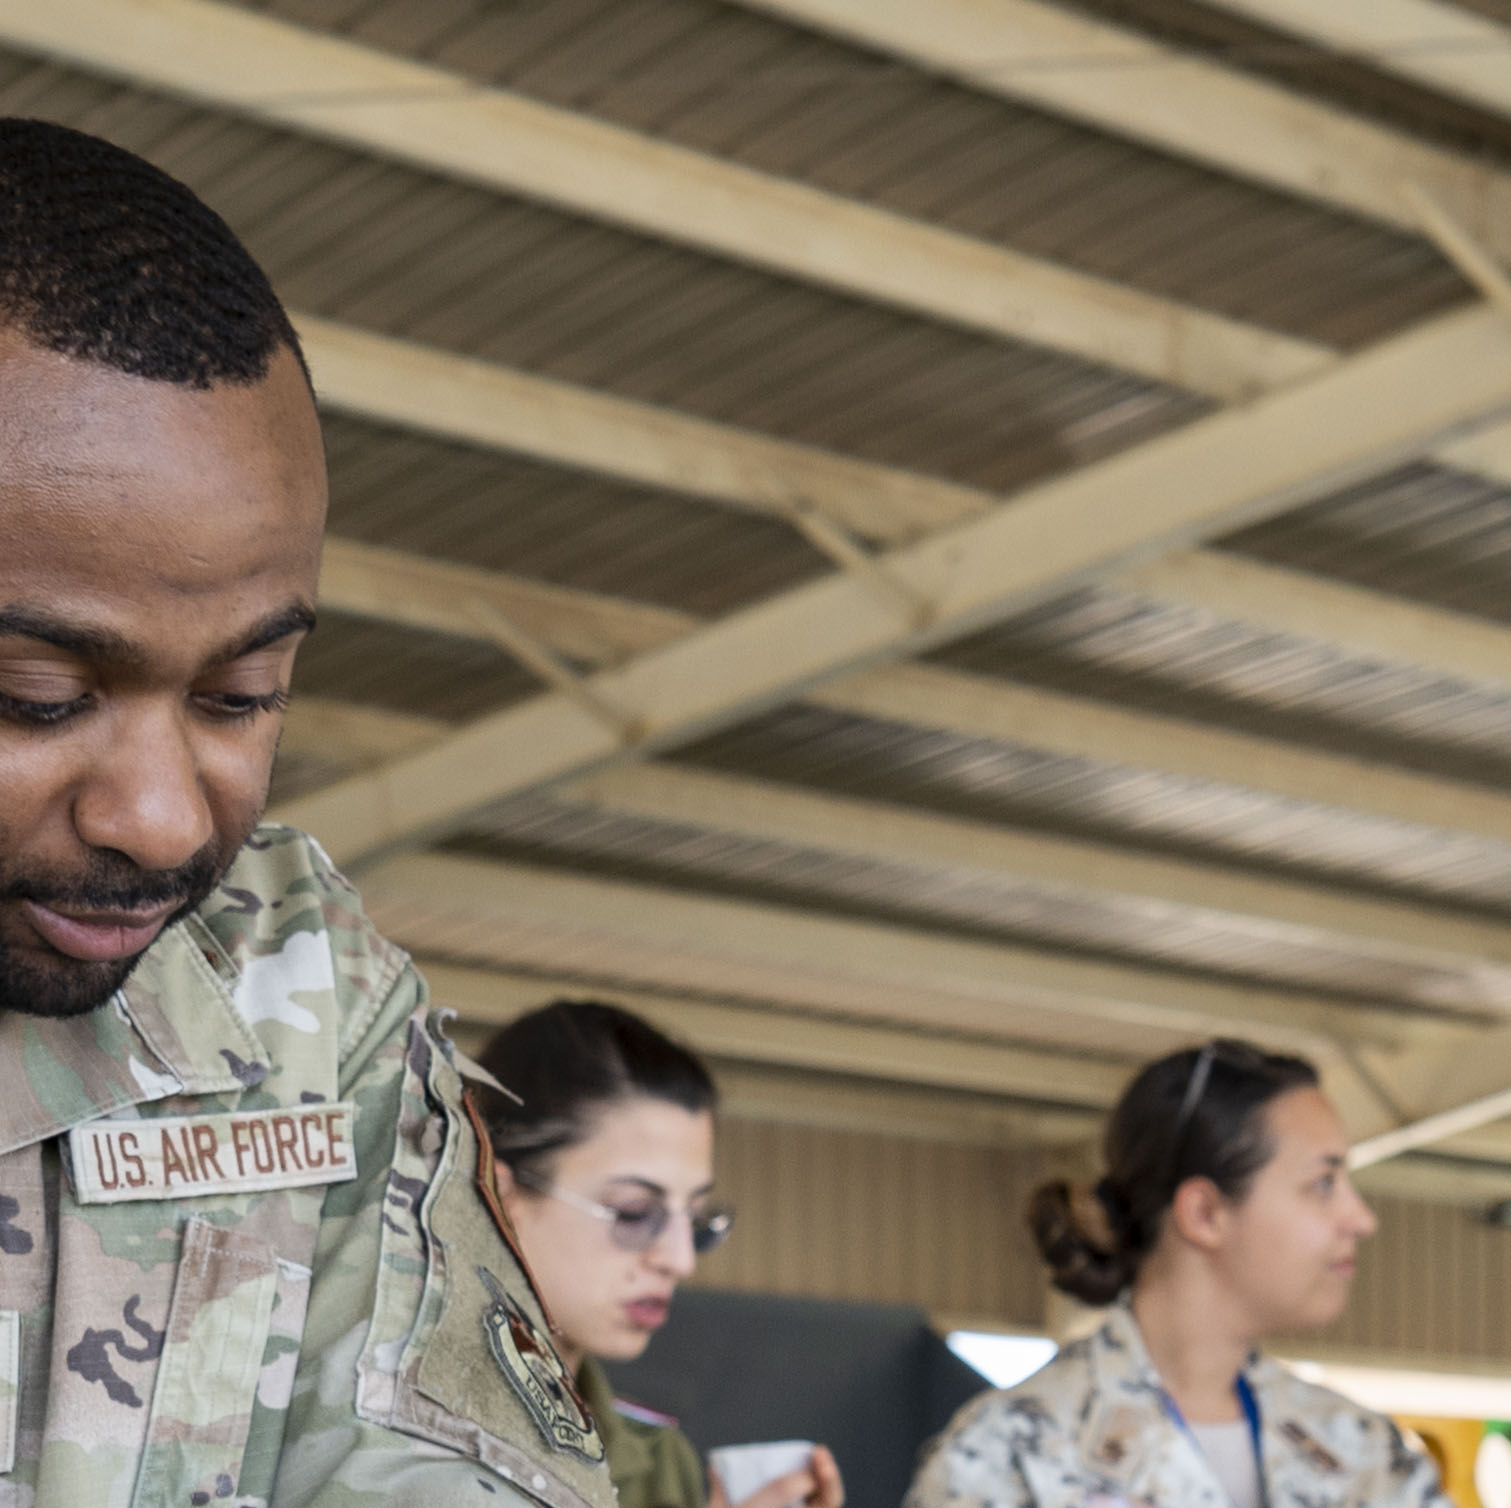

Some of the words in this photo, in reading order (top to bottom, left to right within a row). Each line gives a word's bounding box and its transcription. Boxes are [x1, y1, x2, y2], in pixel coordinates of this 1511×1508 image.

[92, 1131, 154, 1190] U.S.
[160, 1124, 226, 1187] AIR
[231, 1112, 348, 1176] FORCE
